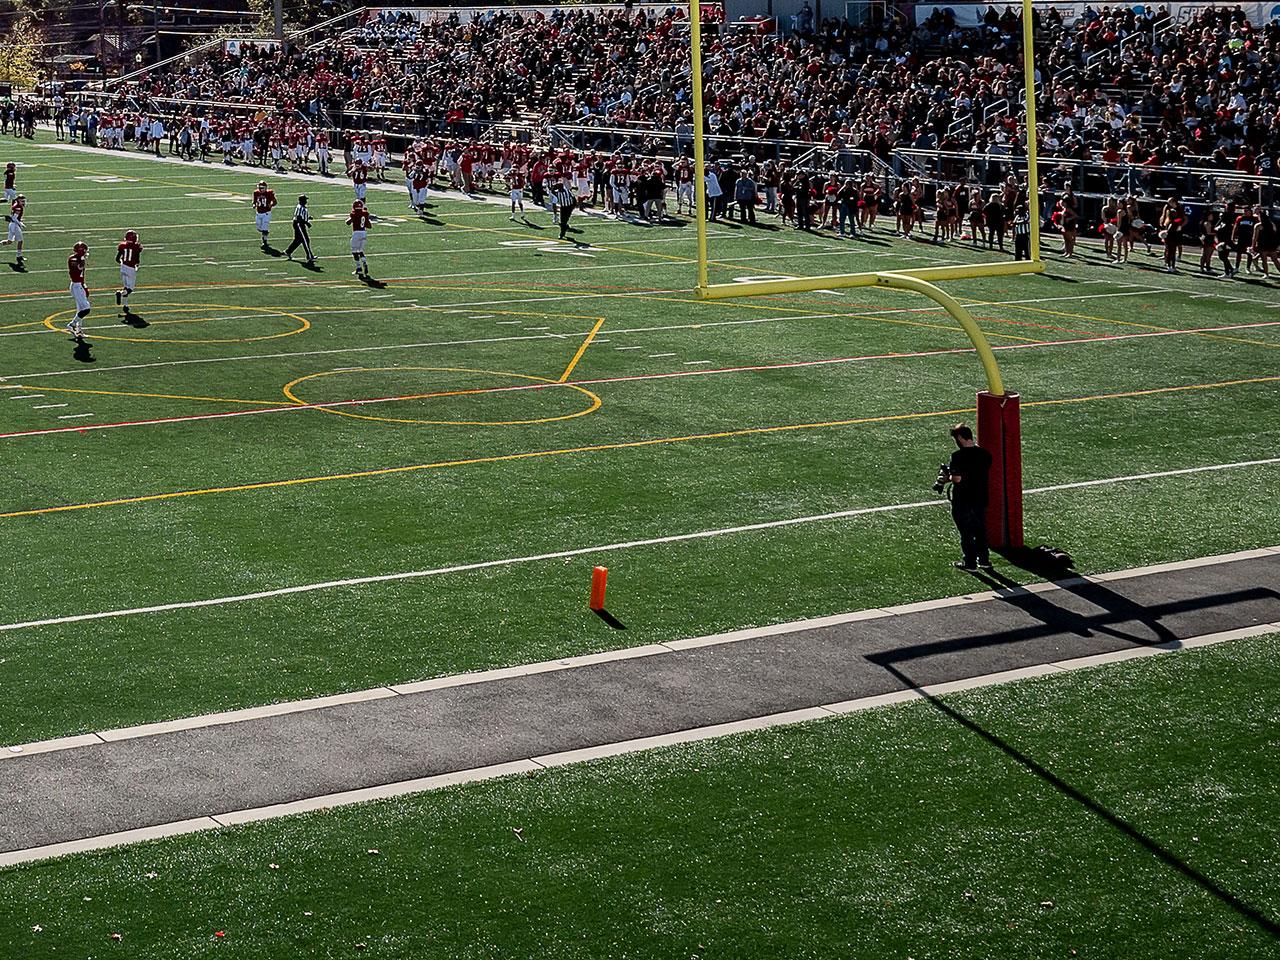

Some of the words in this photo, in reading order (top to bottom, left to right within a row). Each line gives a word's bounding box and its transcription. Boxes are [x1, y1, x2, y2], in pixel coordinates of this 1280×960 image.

[617, 174, 626, 184] 12
[359, 217, 366, 229] 8
[123, 248, 133, 262] 11
